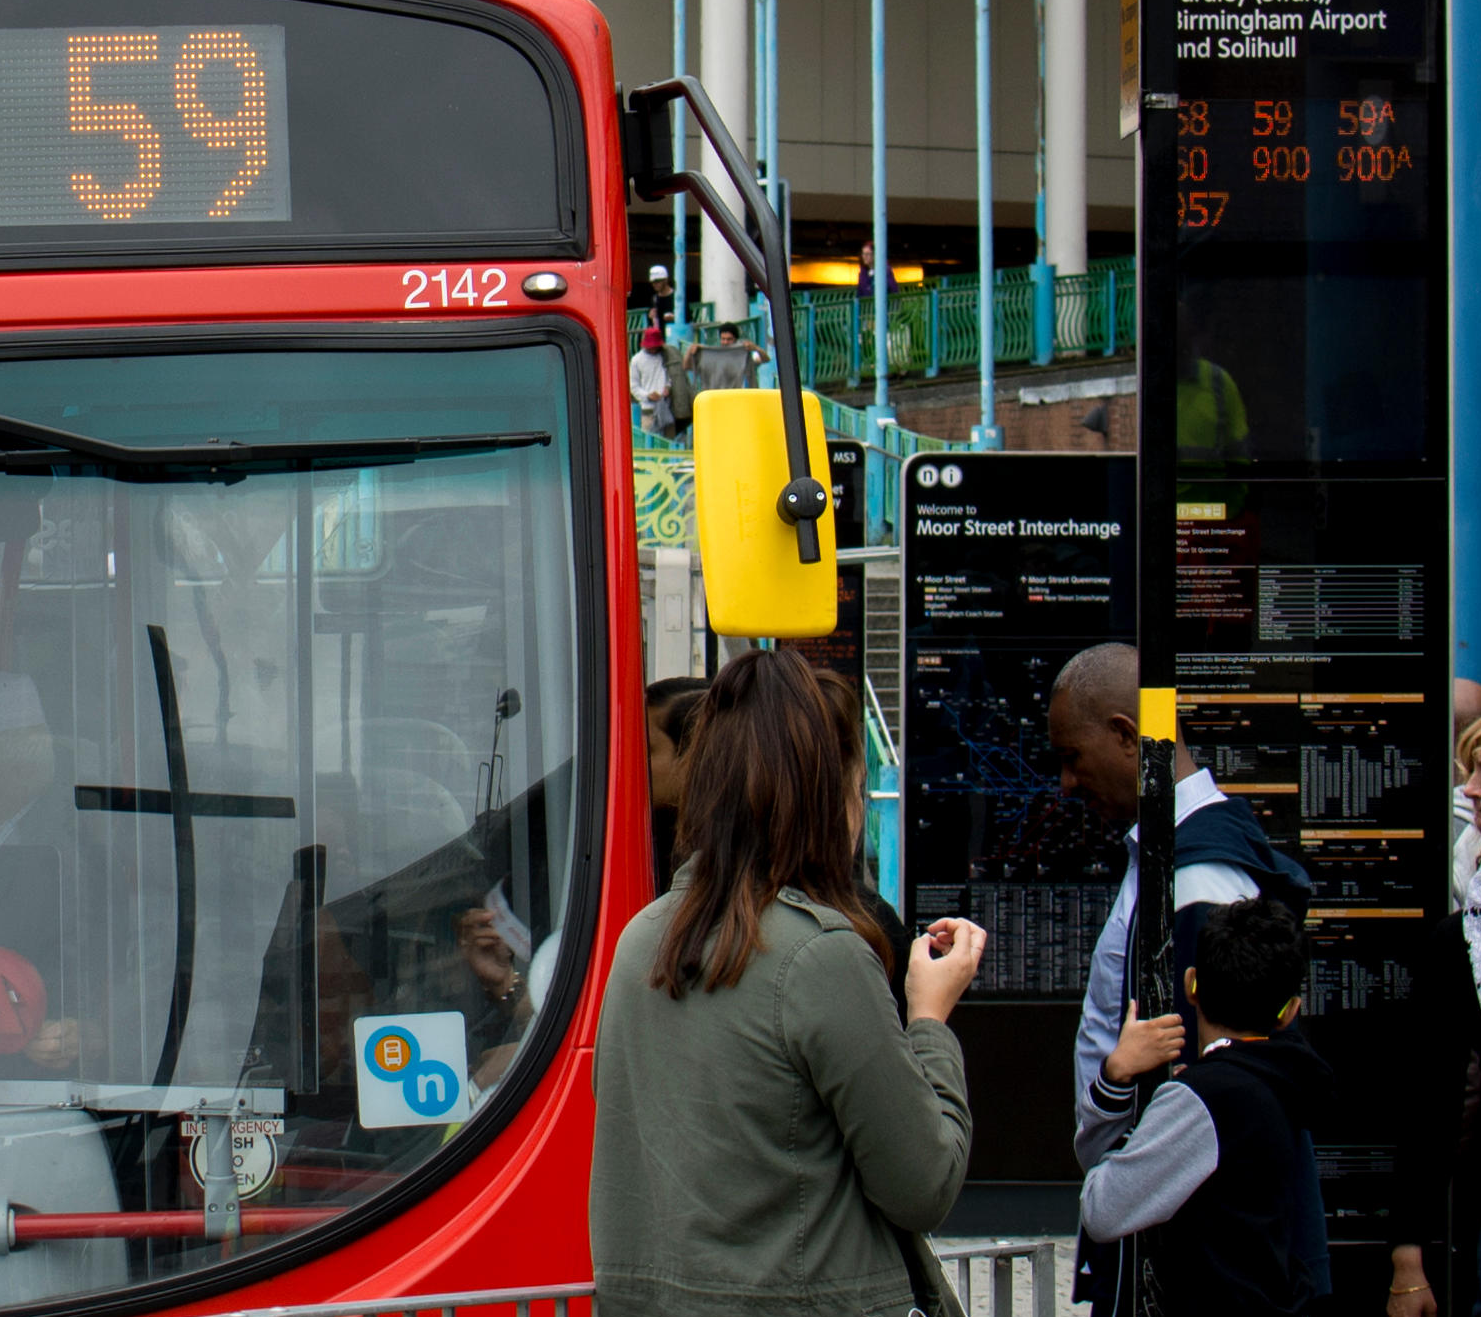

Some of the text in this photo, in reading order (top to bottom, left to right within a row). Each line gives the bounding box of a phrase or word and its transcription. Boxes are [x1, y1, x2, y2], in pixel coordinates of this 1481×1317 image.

[1309, 8, 1387, 35] Airport
[1217, 35, 1297, 59] Solihull
[67, 31, 267, 219] 59
[1252, 100, 1294, 136] 59
[1252, 146, 1311, 182] 900
[401, 267, 509, 309] 2142
[833, 451, 857, 464] MS3
[916, 503, 978, 516] Welcome to
[916, 517, 1121, 540] Moor Street Interchange
[924, 576, 967, 585] Moor Street
[1028, 576, 1112, 587] Moor Street Queensway
[186, 1120, 280, 1135] IN ERGENCY
[233, 1137, 254, 1149] SH
[237, 1173, 255, 1186] EN
